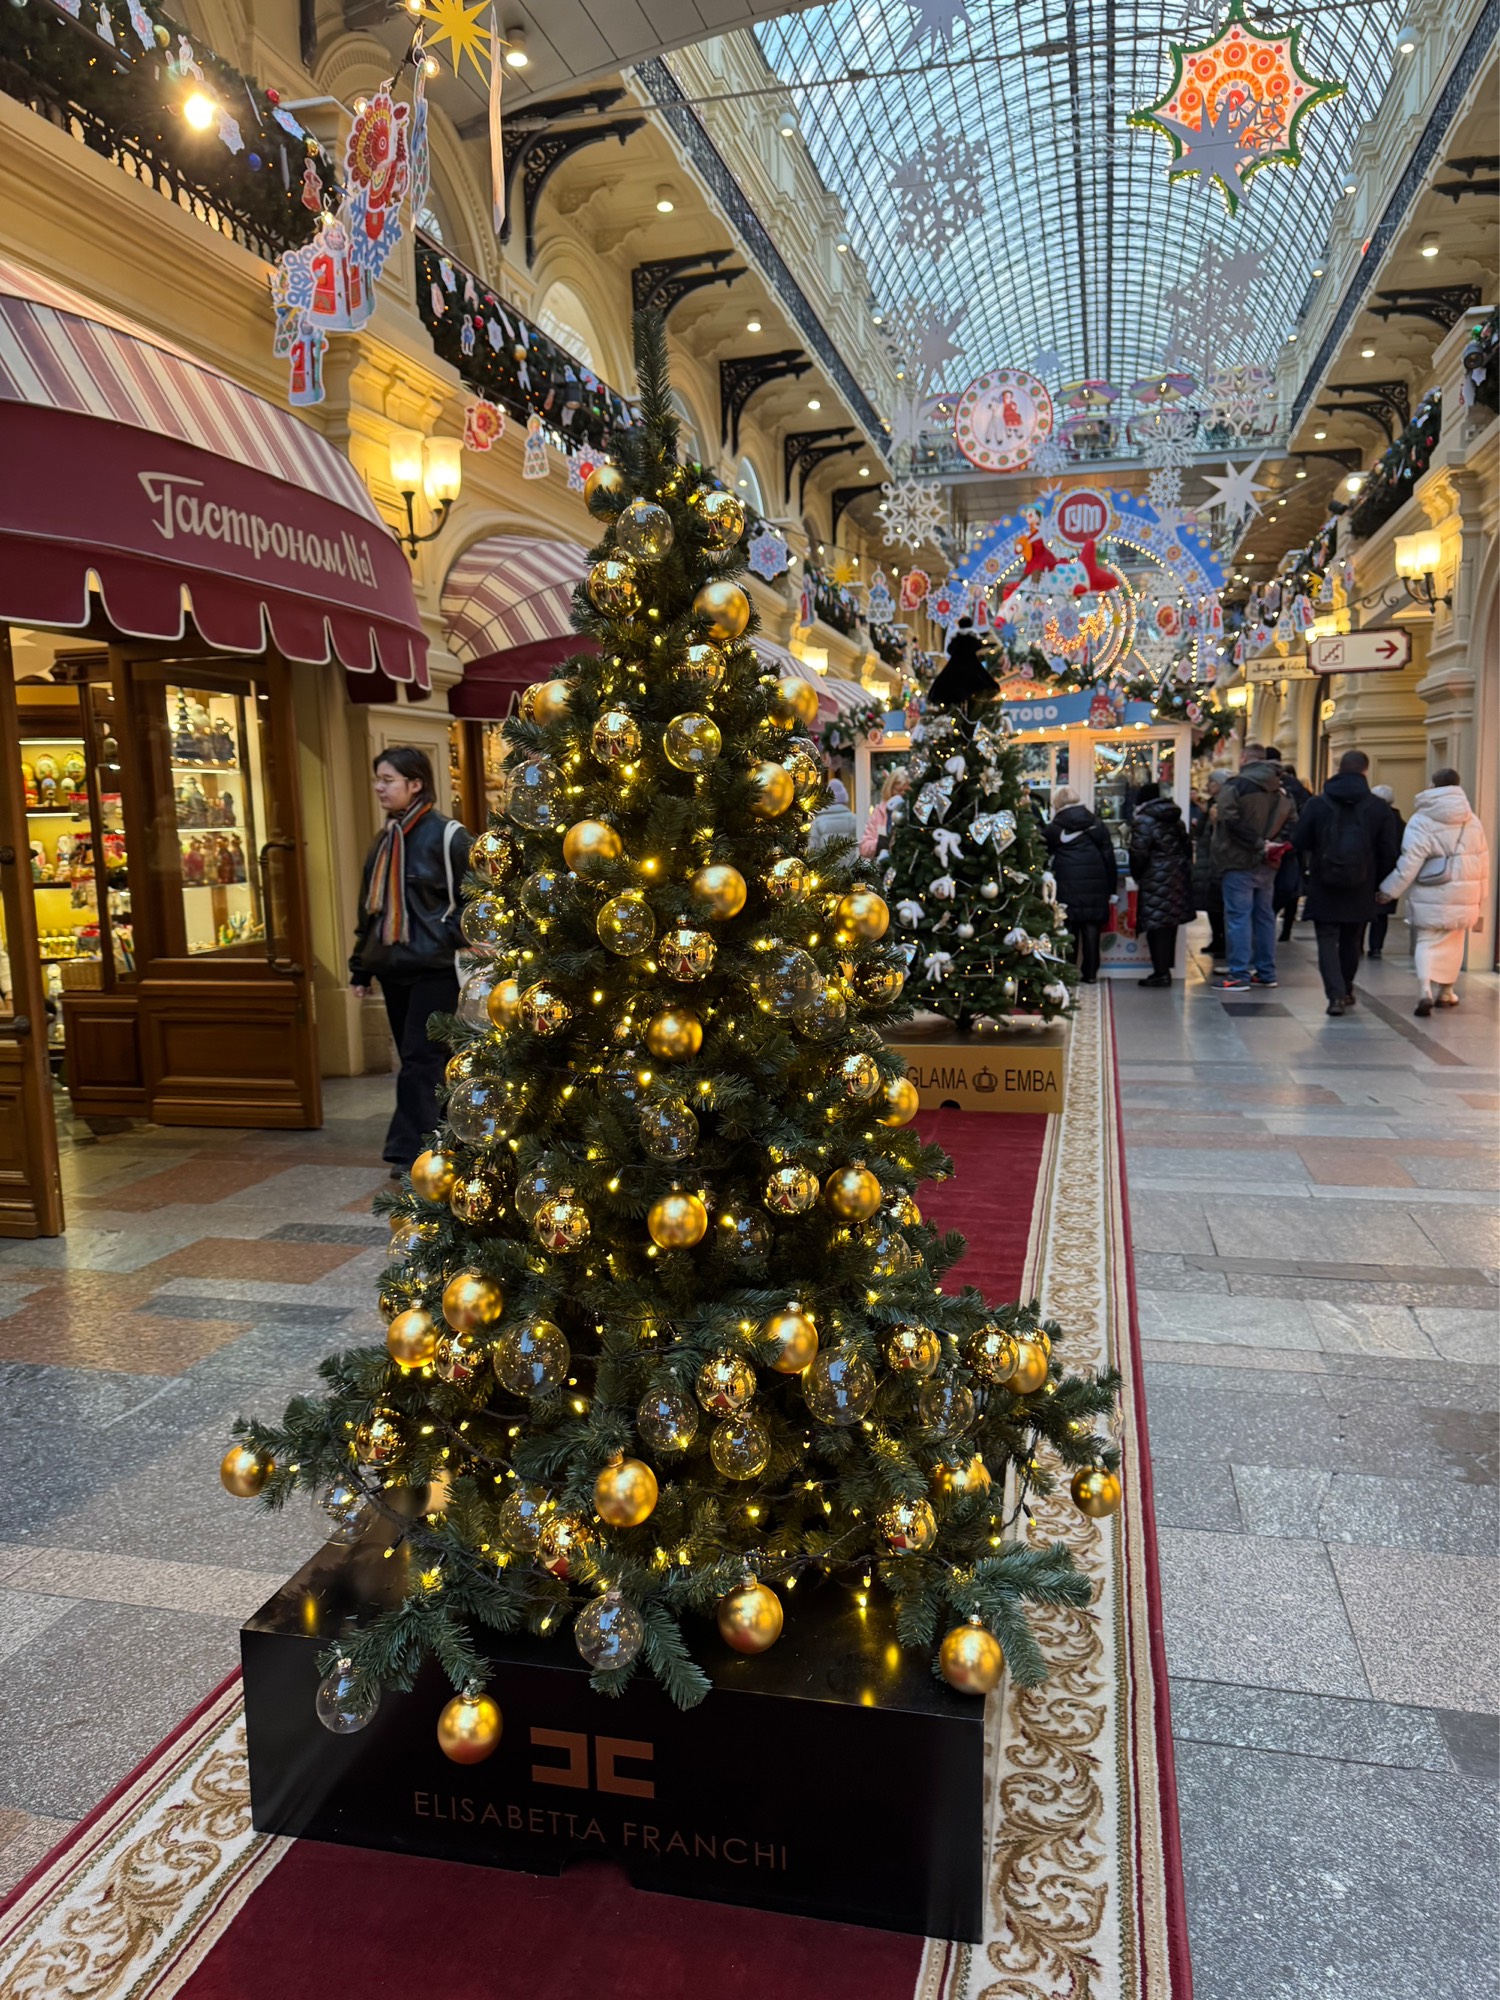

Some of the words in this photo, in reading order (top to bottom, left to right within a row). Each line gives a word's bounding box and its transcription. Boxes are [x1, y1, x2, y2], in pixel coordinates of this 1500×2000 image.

[137, 471, 346, 577] Гастроном
[340, 530, 379, 590] №1
[1064, 503, 1102, 534] ГУМ
[1004, 1069, 1058, 1093] EMBA
[414, 1791, 606, 1844] ELISABETTA
[622, 1822, 787, 1871] FRANCHI
